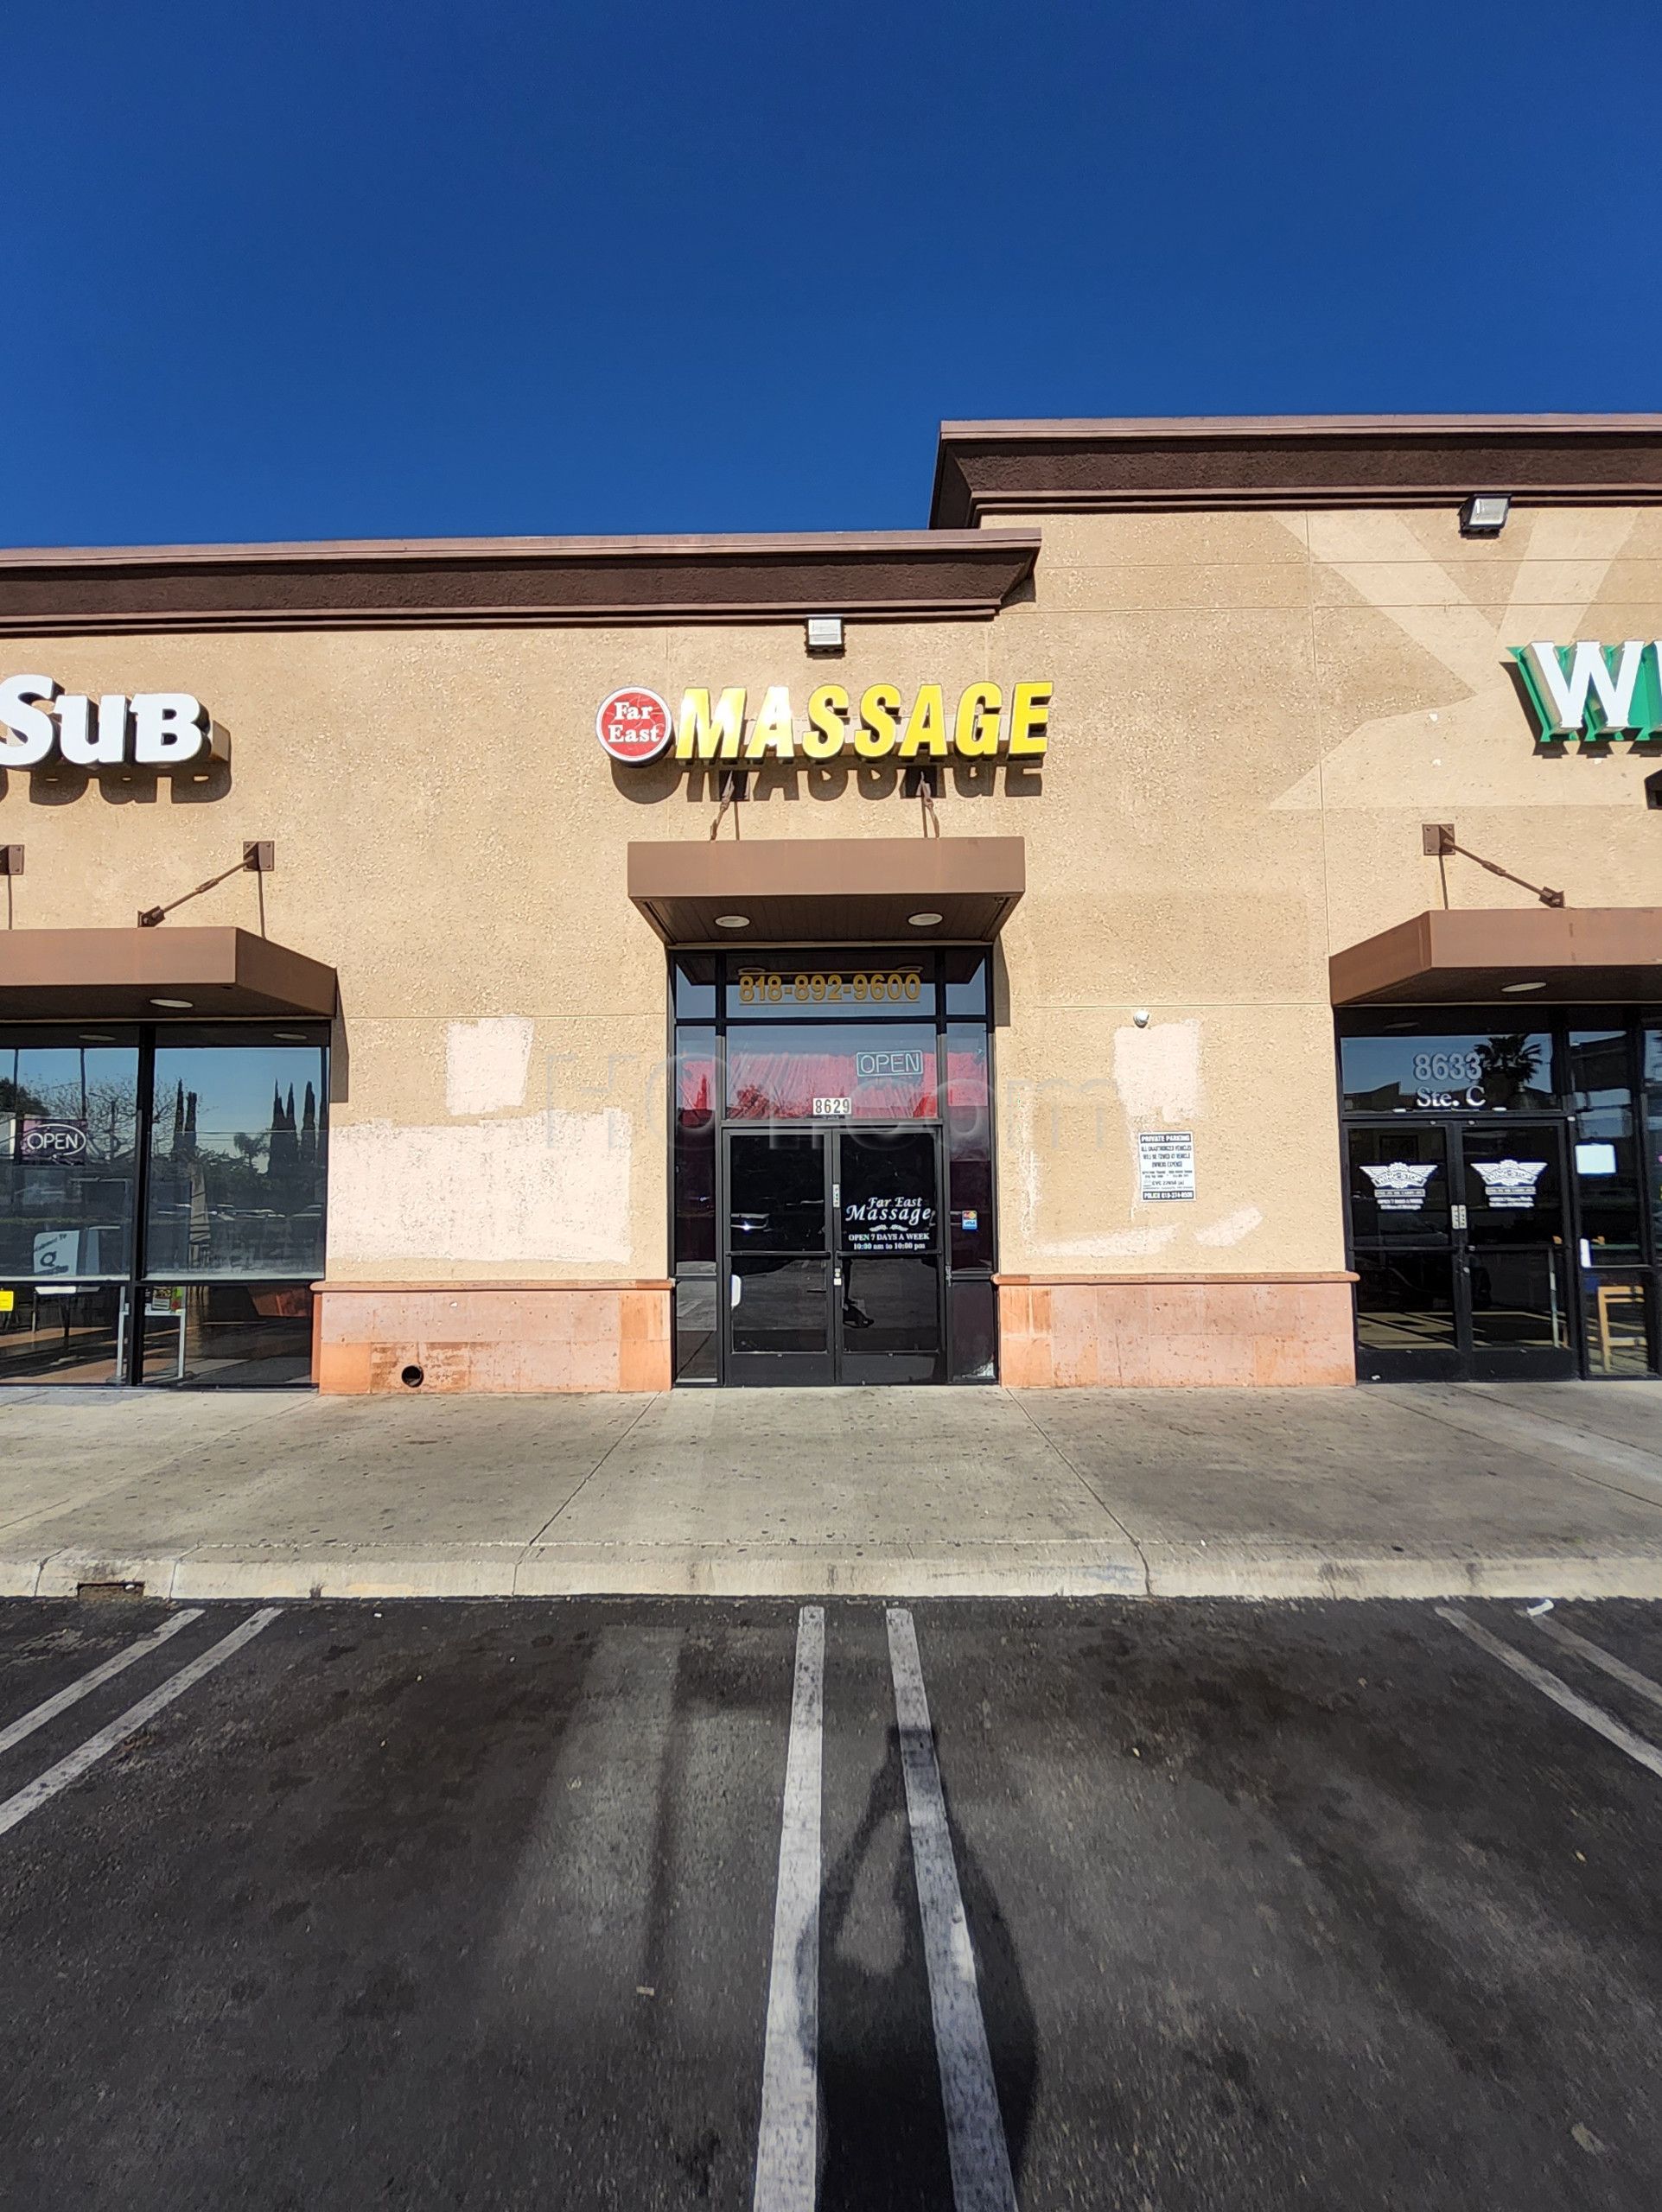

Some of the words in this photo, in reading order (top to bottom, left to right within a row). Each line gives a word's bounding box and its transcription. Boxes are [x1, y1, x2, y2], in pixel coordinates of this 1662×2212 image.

[614, 702, 653, 721] Far
[675, 681, 1053, 760] MASSAGE
[608, 724, 660, 743] East
[739, 973, 920, 1001] 818-892-9600
[861, 1053, 919, 1073] OPEN
[1413, 1052, 1482, 1080] 8633
[815, 1098, 850, 1114] 8629
[1417, 1086, 1460, 1107] Ste.
[1466, 1085, 1486, 1106] C
[28, 1132, 78, 1150] OPEN
[866, 1197, 892, 1210] Far
[895, 1197, 923, 1208] East
[845, 1205, 932, 1226] Massage
